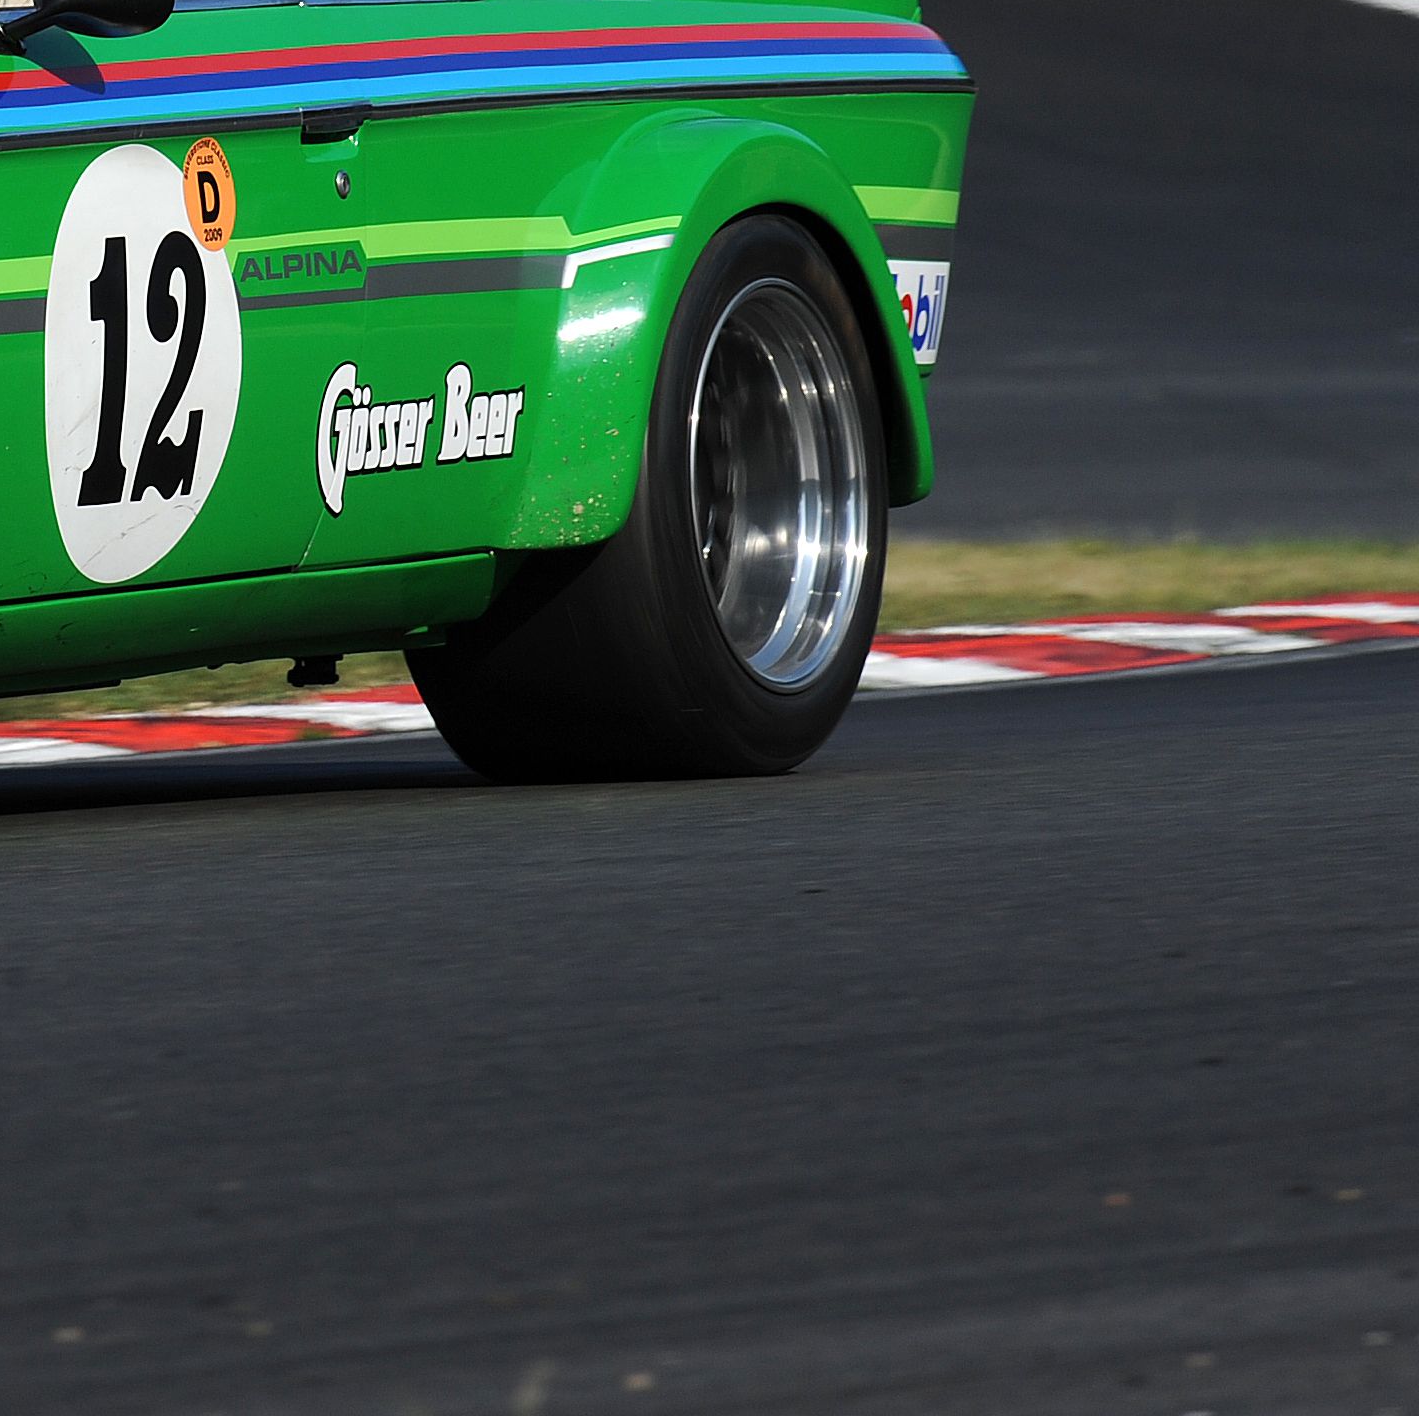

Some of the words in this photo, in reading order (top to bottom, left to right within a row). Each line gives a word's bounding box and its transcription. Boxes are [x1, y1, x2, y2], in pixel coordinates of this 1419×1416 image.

[196, 154, 215, 166] CLASS
[196, 170, 221, 224] D
[203, 227, 223, 243] 2009
[241, 249, 363, 283] ALPINA
[77, 230, 205, 506] 12
[316, 360, 435, 519] Gösser
[436, 361, 525, 466] Beer
